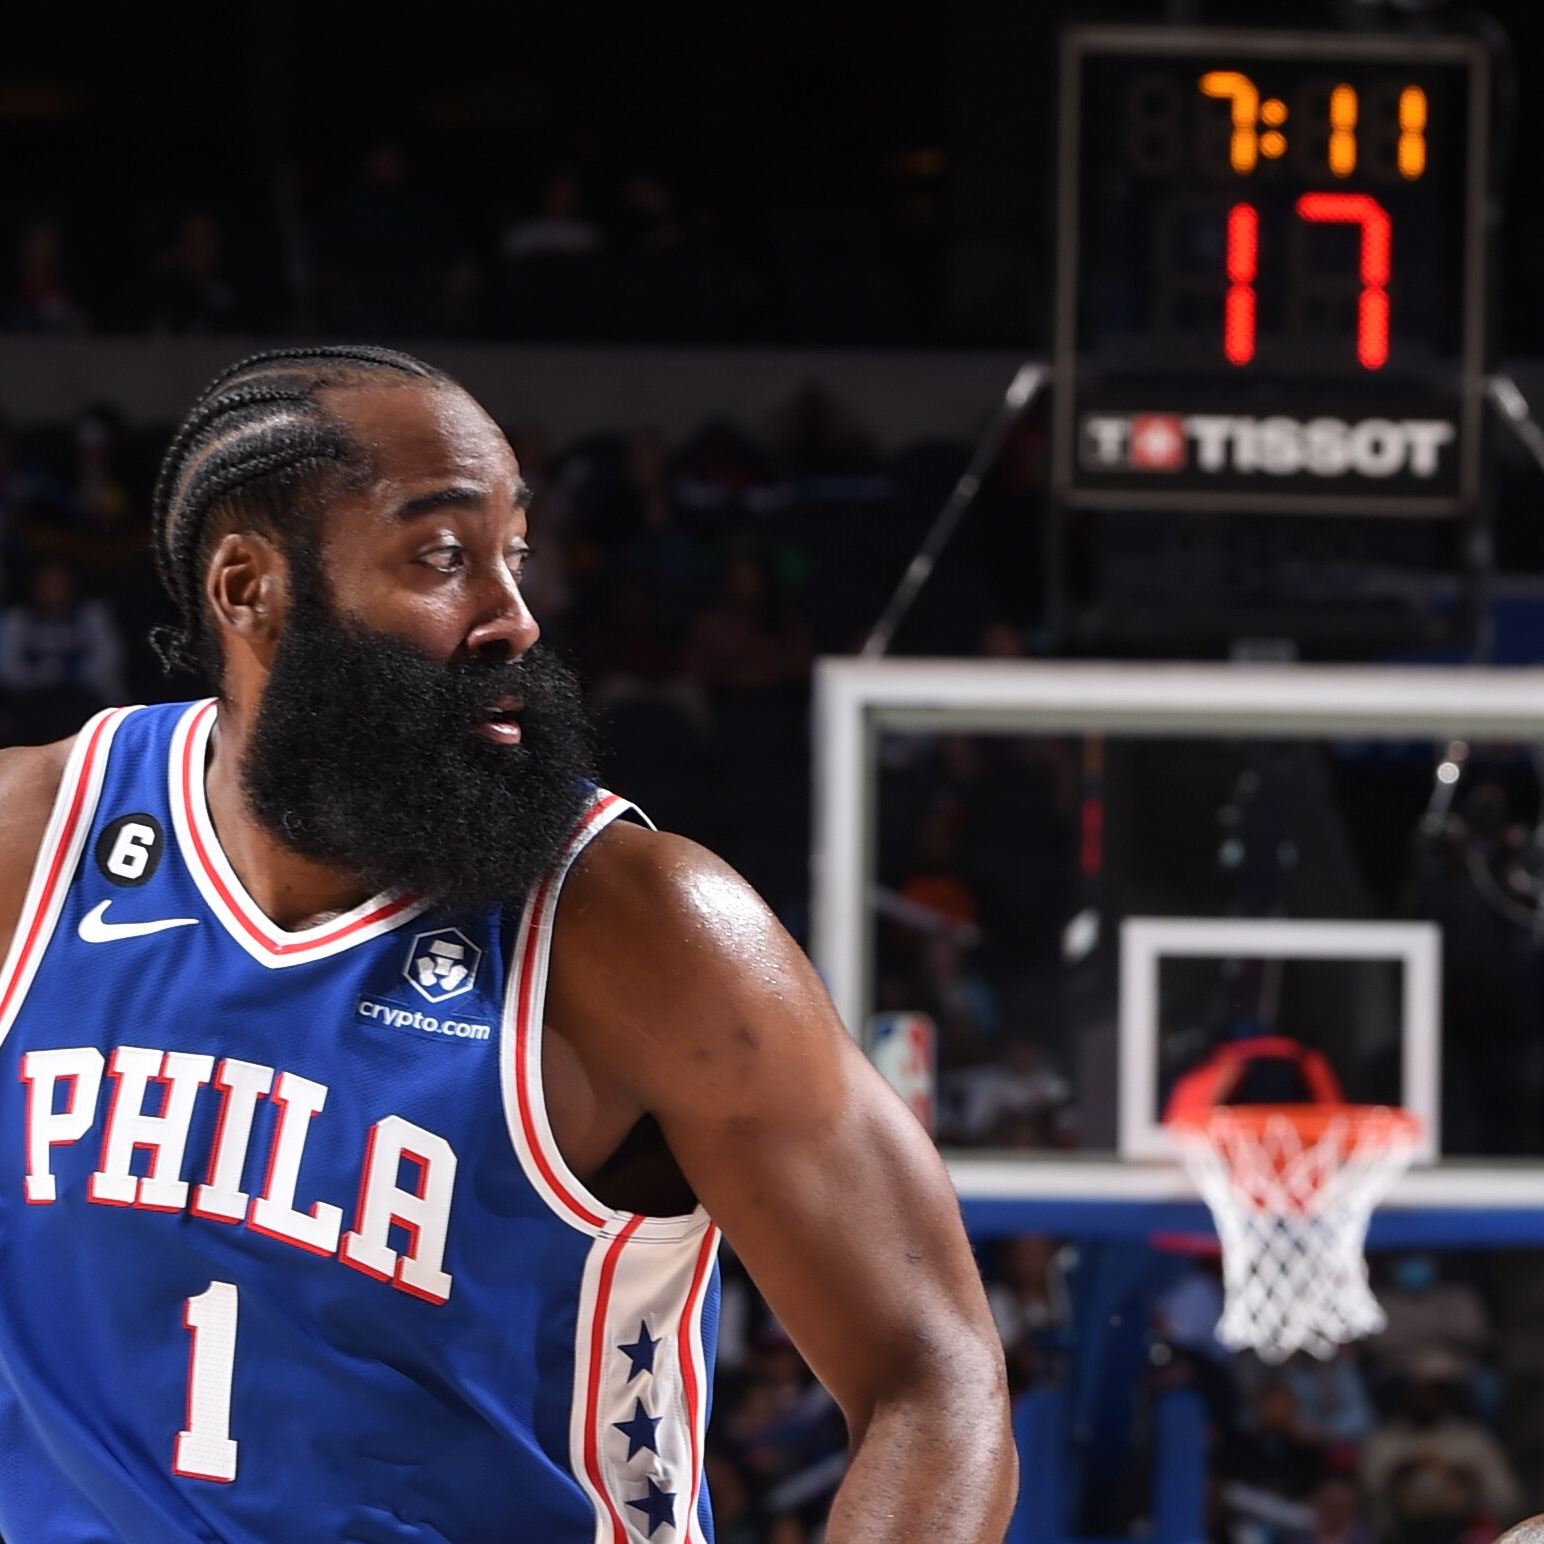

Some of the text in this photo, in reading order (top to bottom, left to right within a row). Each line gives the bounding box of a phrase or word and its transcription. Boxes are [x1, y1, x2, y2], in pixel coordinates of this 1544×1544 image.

[1198, 71, 1428, 181] 7:11
[1224, 192, 1392, 370] 17
[1184, 415, 1453, 478] TISSOT
[106, 823, 155, 879] 6
[358, 1001, 491, 1040] crypto.com
[22, 1046, 458, 1305] PHILA
[173, 1281, 239, 1483] 1
